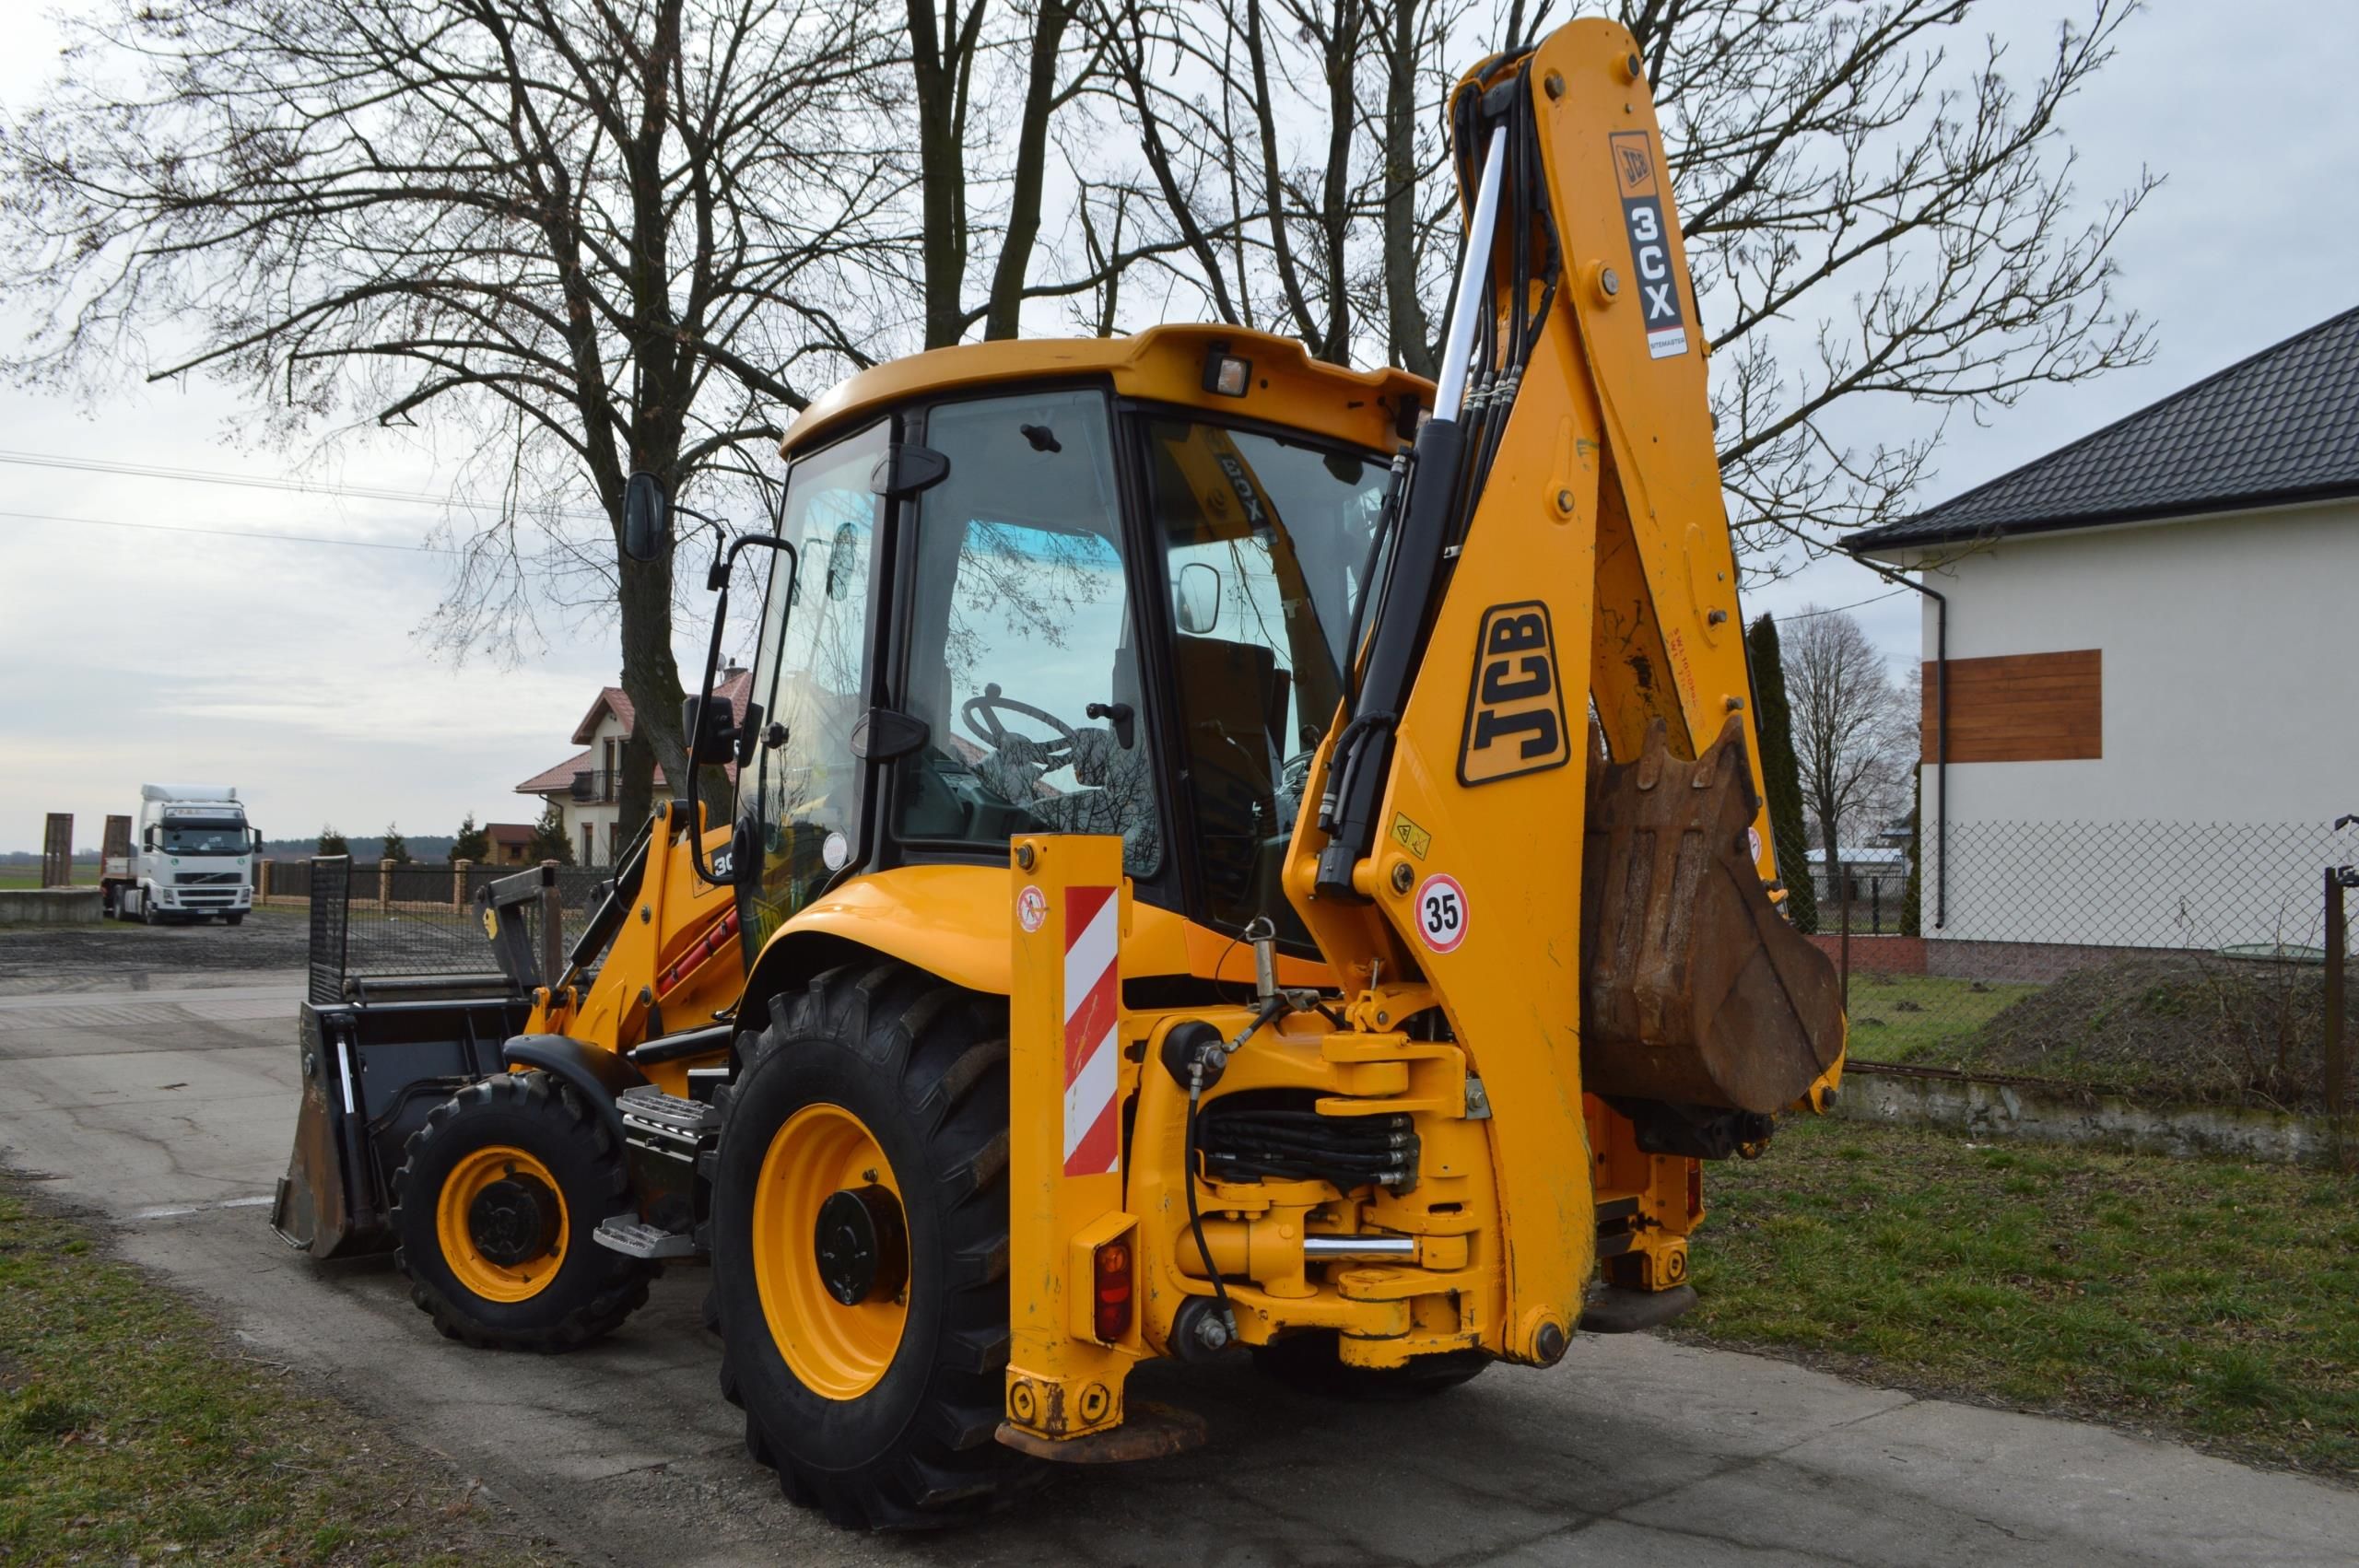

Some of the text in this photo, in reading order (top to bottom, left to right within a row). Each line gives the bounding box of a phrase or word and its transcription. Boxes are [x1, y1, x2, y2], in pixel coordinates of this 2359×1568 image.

[1623, 150, 1648, 183] JCB
[1631, 206, 1675, 320] 3CX
[1473, 613, 1559, 760] JCB
[1426, 894, 1459, 933] 35
